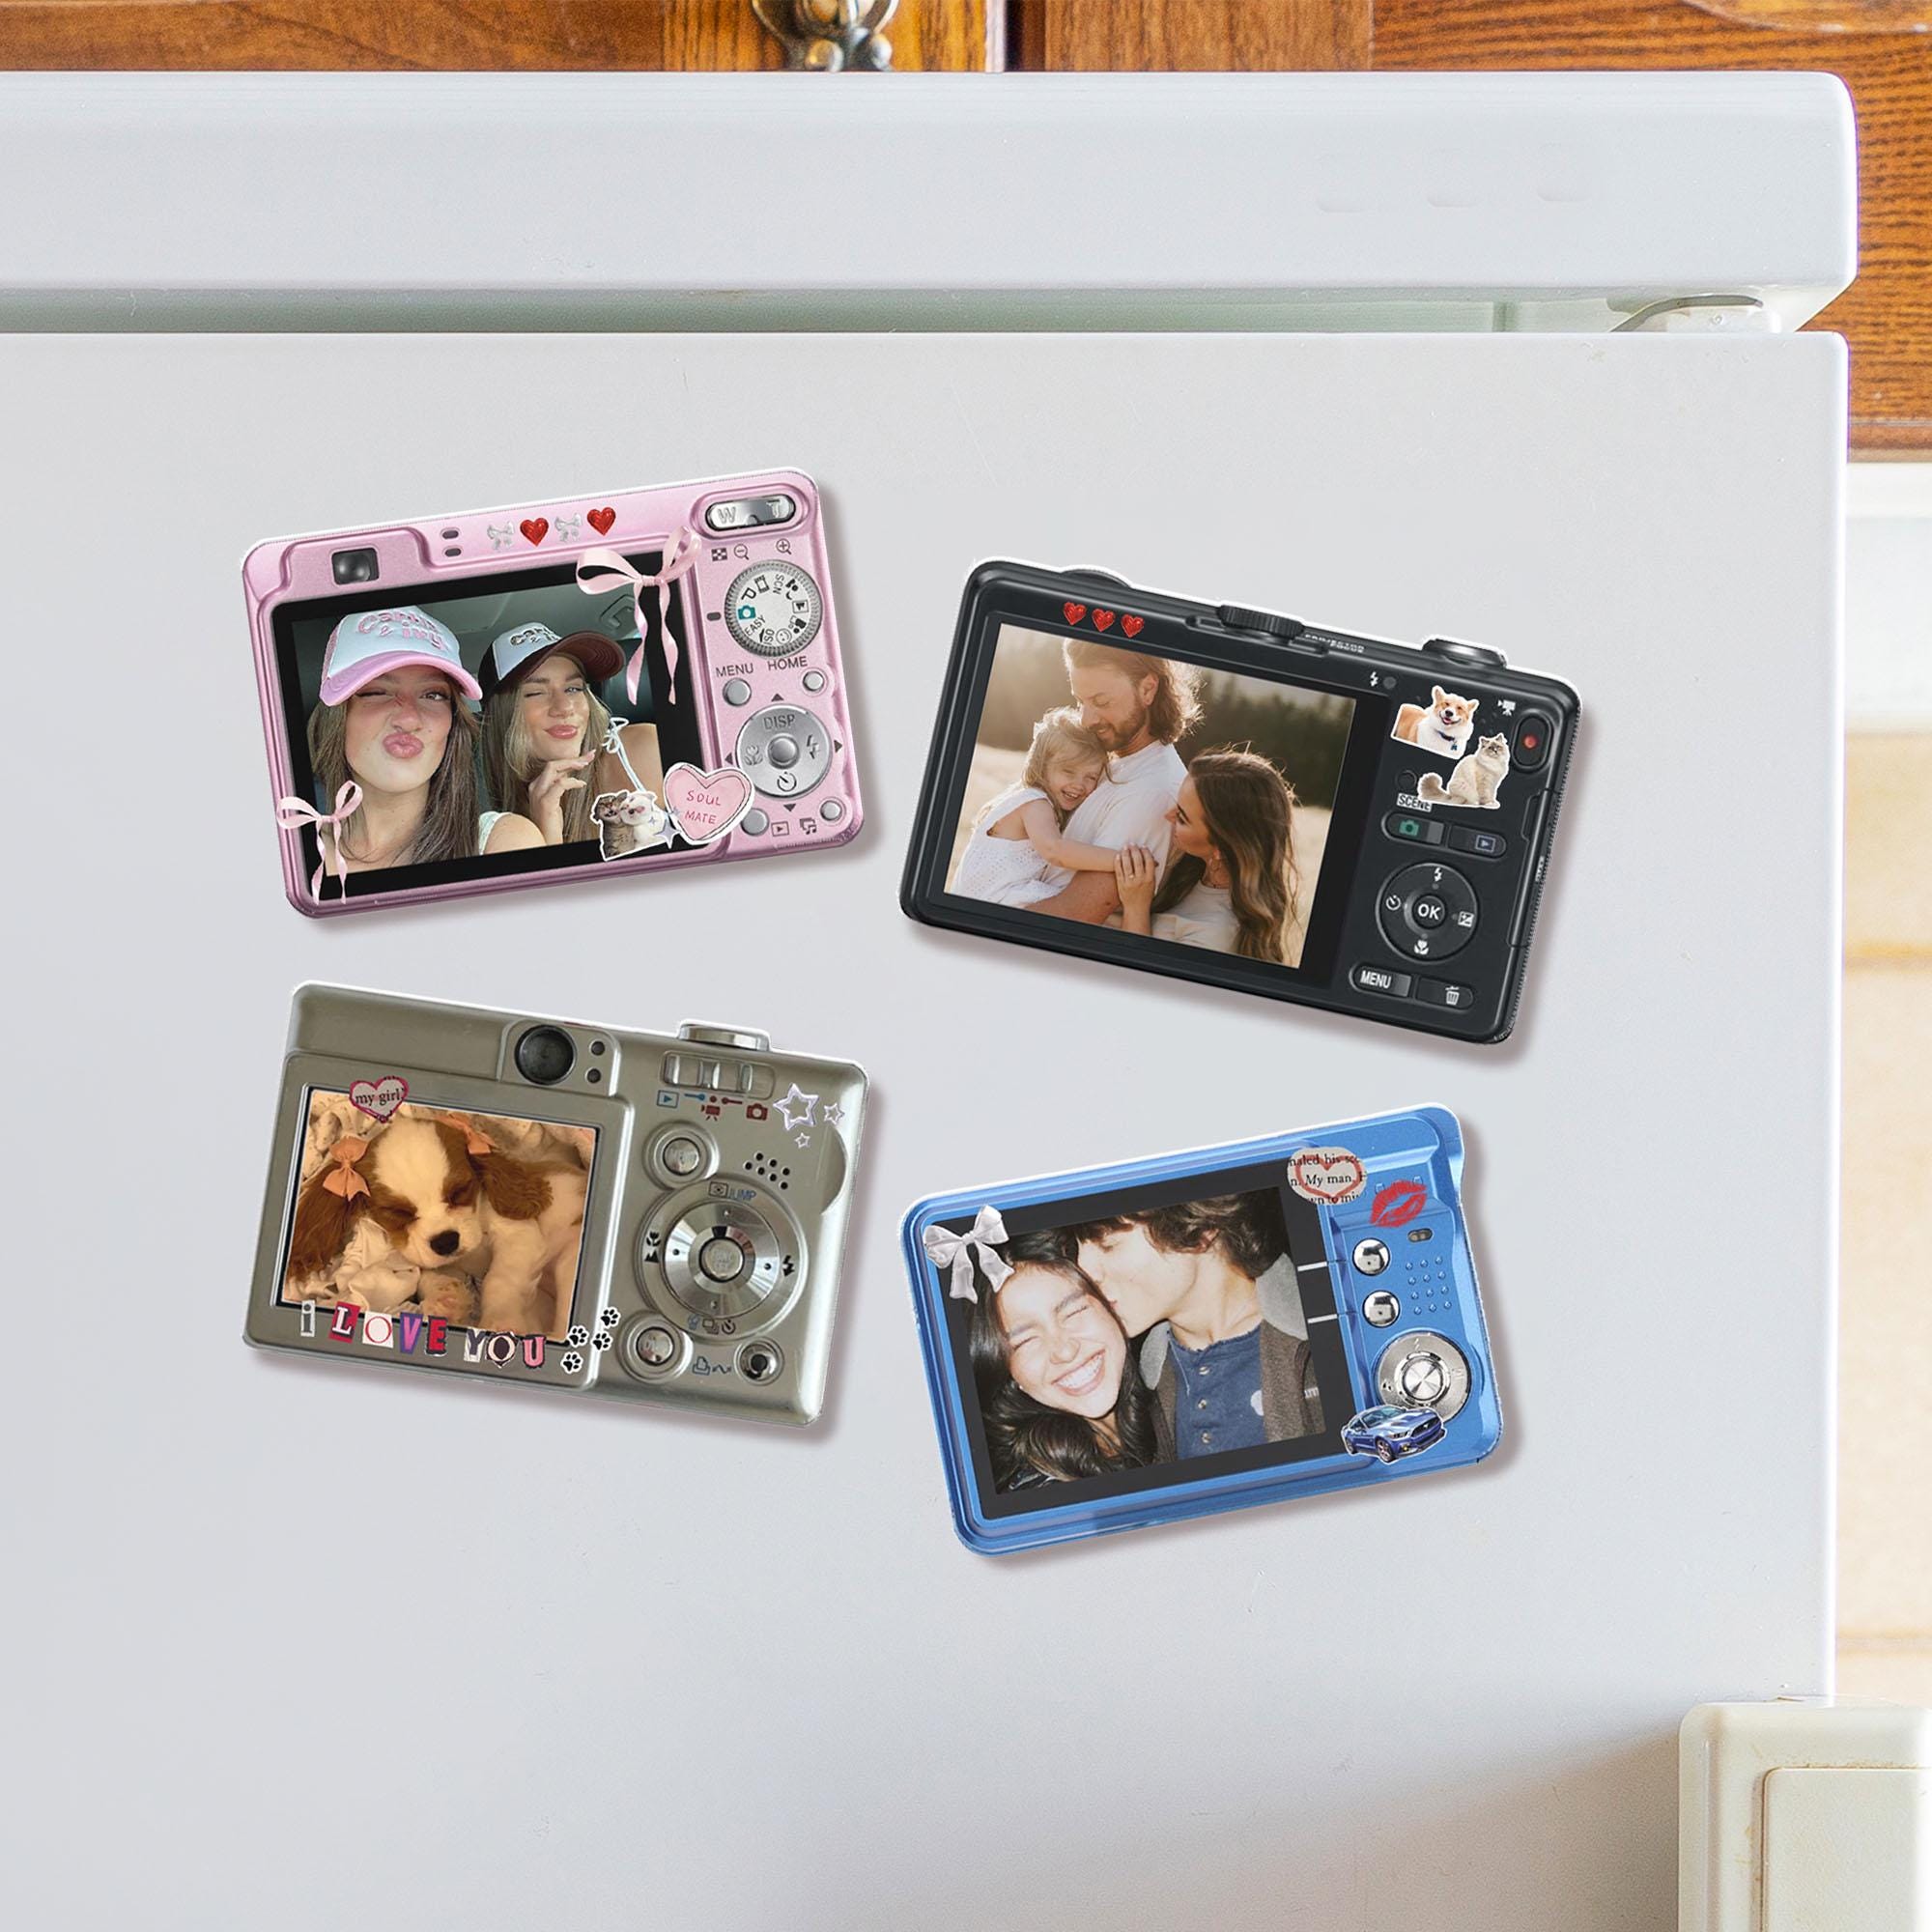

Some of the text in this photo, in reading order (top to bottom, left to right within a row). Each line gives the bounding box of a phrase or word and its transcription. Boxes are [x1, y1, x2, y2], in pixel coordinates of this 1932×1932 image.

[717, 505, 736, 524] W
[741, 587, 757, 600] P
[744, 614, 766, 637] EASY
[716, 663, 753, 677] MENU
[767, 656, 809, 670] HOME
[763, 714, 795, 730] DISP
[686, 789, 722, 807] SOUL
[684, 810, 717, 825] MATE
[1417, 903, 1441, 920] OK
[1359, 970, 1392, 988] MENU
[355, 1094, 374, 1106] my
[1305, 1174, 1323, 1188] My
[331, 1305, 447, 1352] LOVE
[466, 1328, 546, 1367] YOU
